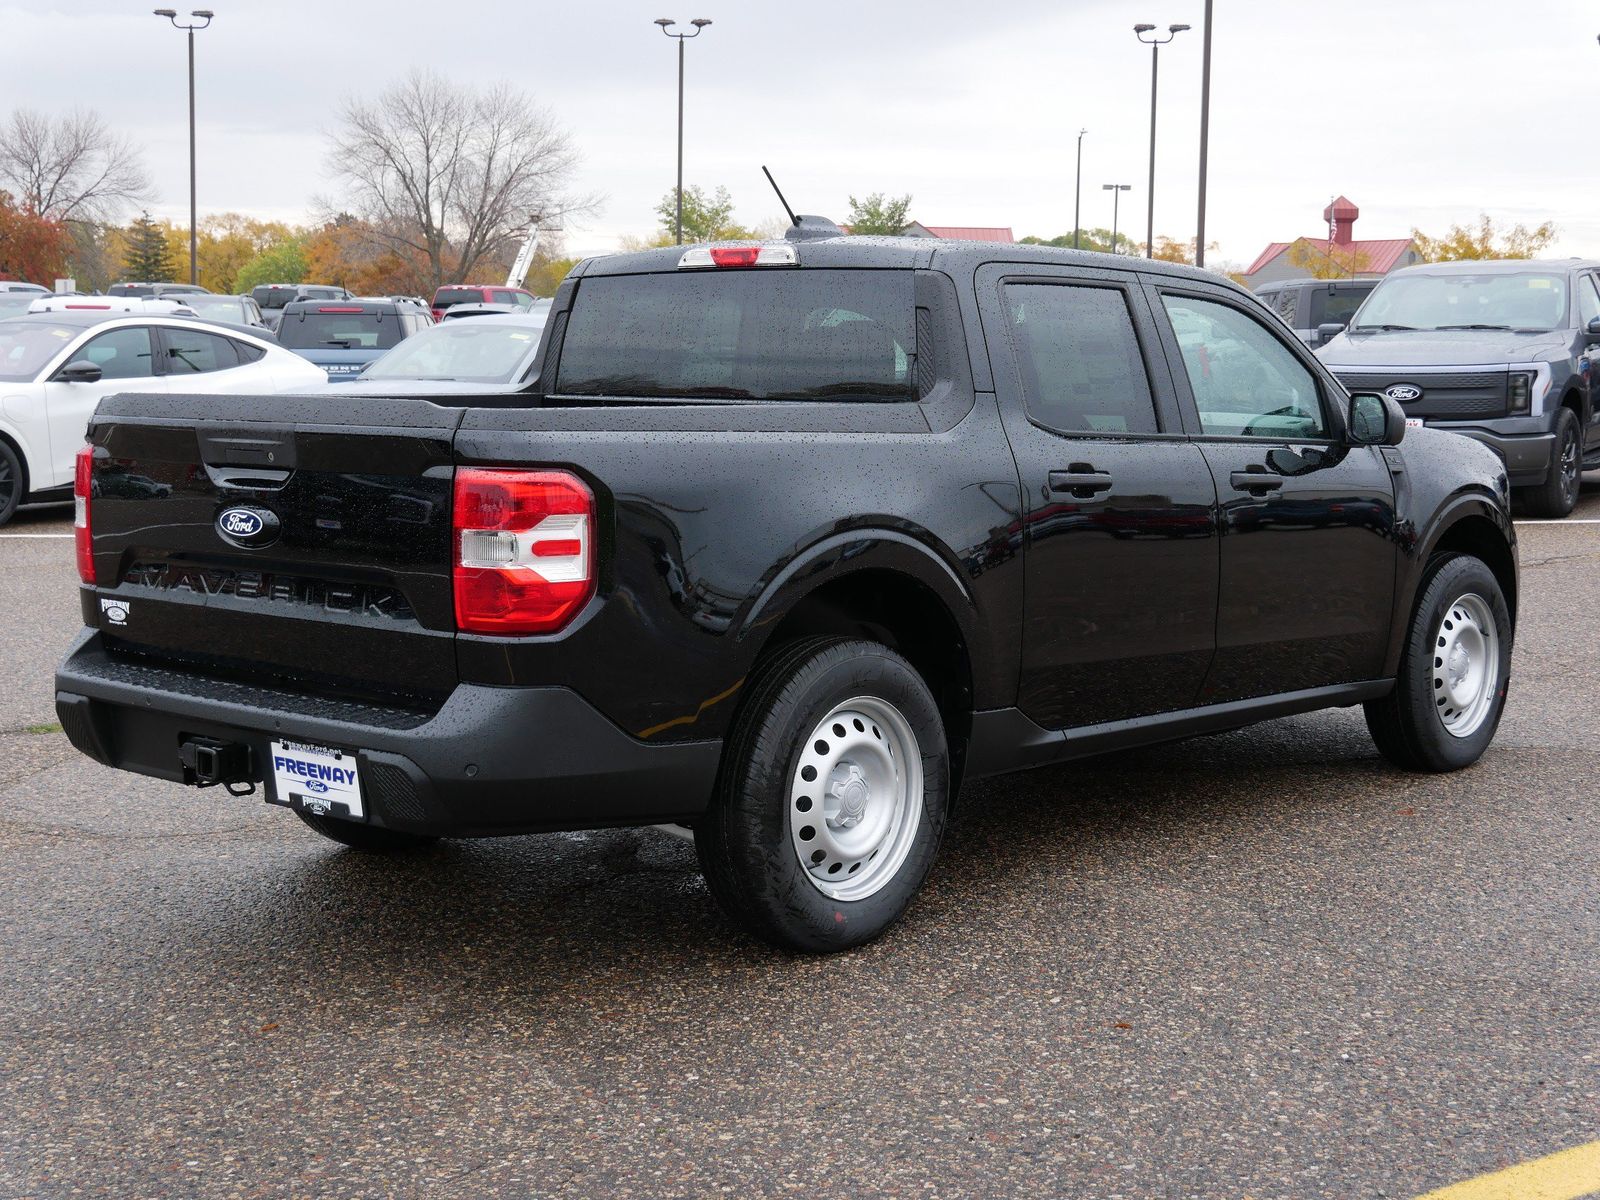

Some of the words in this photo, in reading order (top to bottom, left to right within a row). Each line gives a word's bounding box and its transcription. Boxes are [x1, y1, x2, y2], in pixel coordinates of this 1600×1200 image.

[1391, 387, 1414, 398] Ford
[226, 512, 255, 533] Ford
[138, 571, 393, 618] MAVERICK
[274, 755, 356, 785] FREEWAY
[308, 780, 326, 793] Ford
